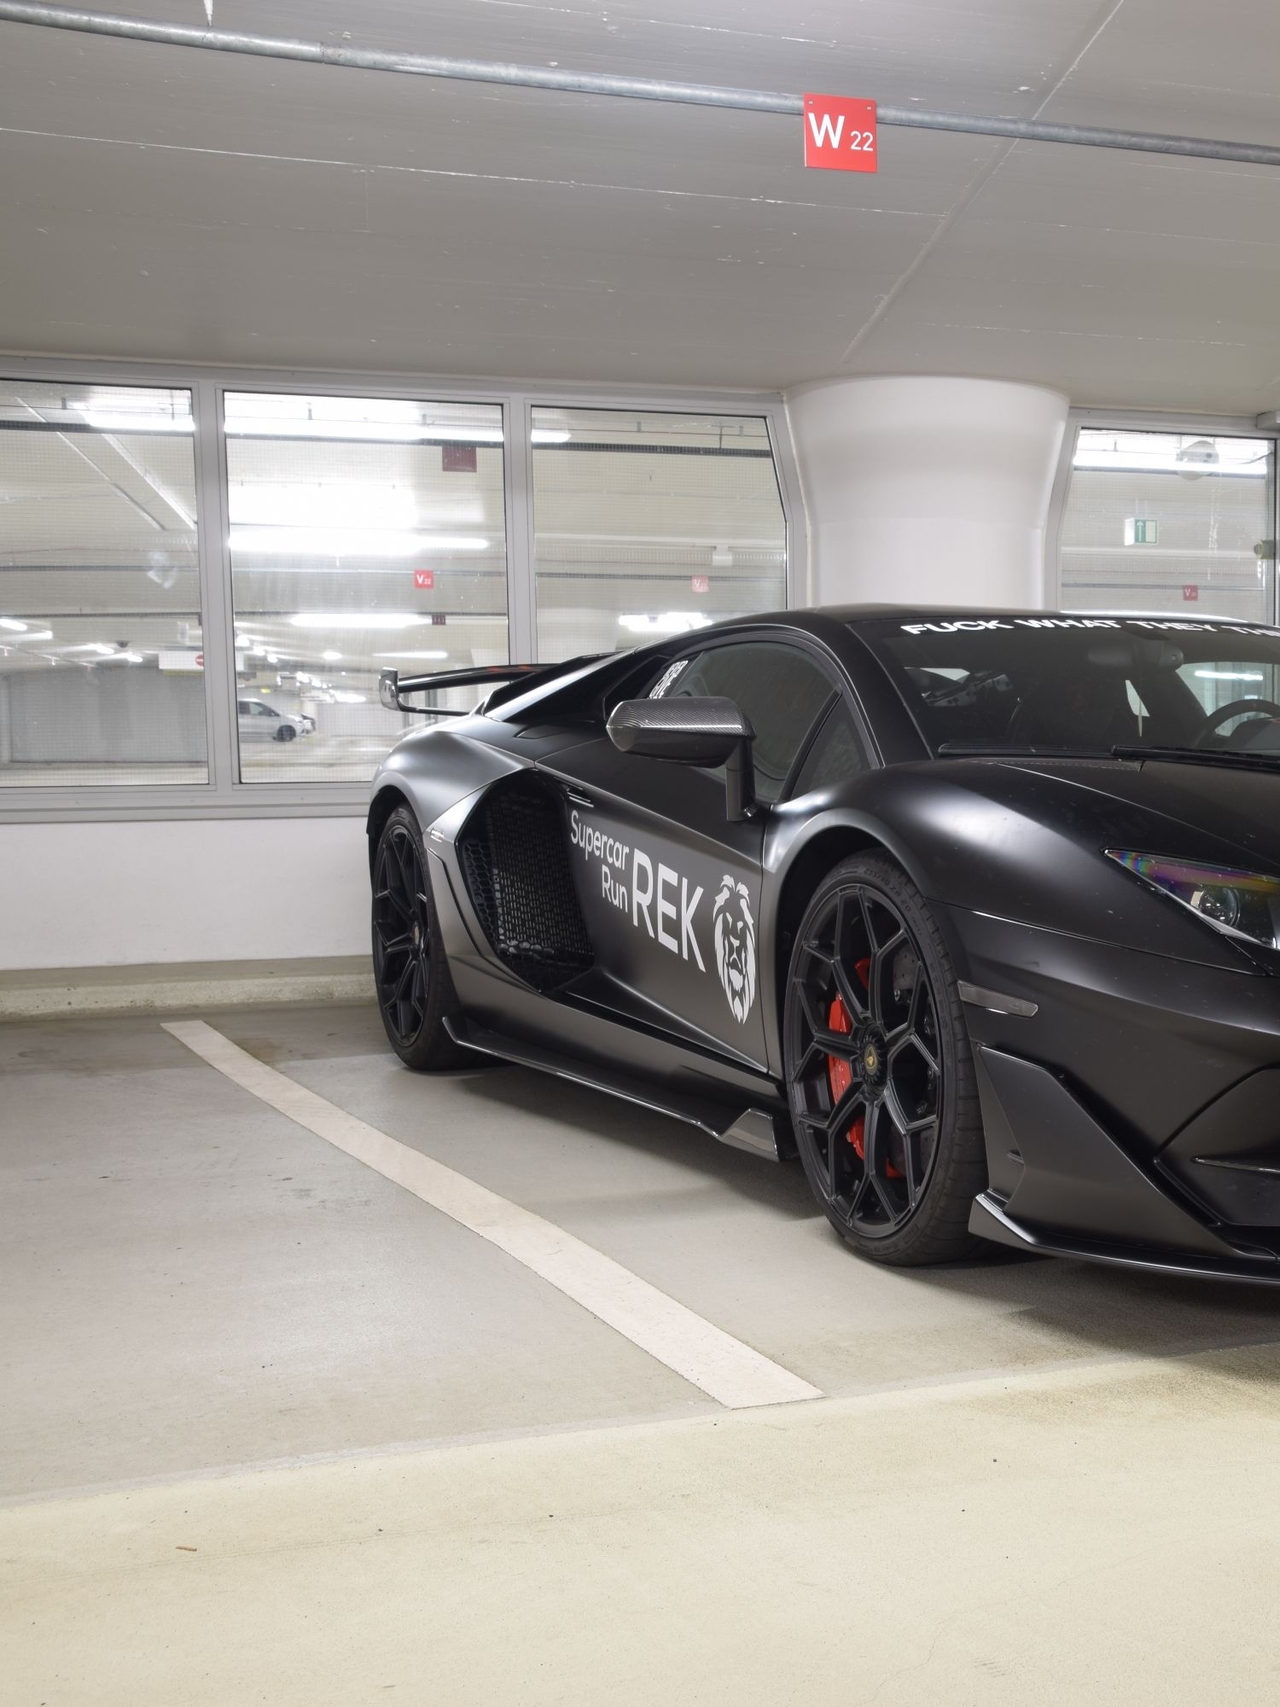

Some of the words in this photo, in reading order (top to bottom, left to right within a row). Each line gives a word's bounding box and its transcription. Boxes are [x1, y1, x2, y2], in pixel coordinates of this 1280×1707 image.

[807, 112, 845, 149] W
[850, 130, 874, 152] 22
[900, 619, 1015, 635] FUCK
[1013, 619, 1122, 629] WHAT
[1126, 620, 1218, 632] THEY
[570, 810, 629, 870] Supercar
[602, 864, 628, 913] Run
[632, 848, 706, 973] REK
